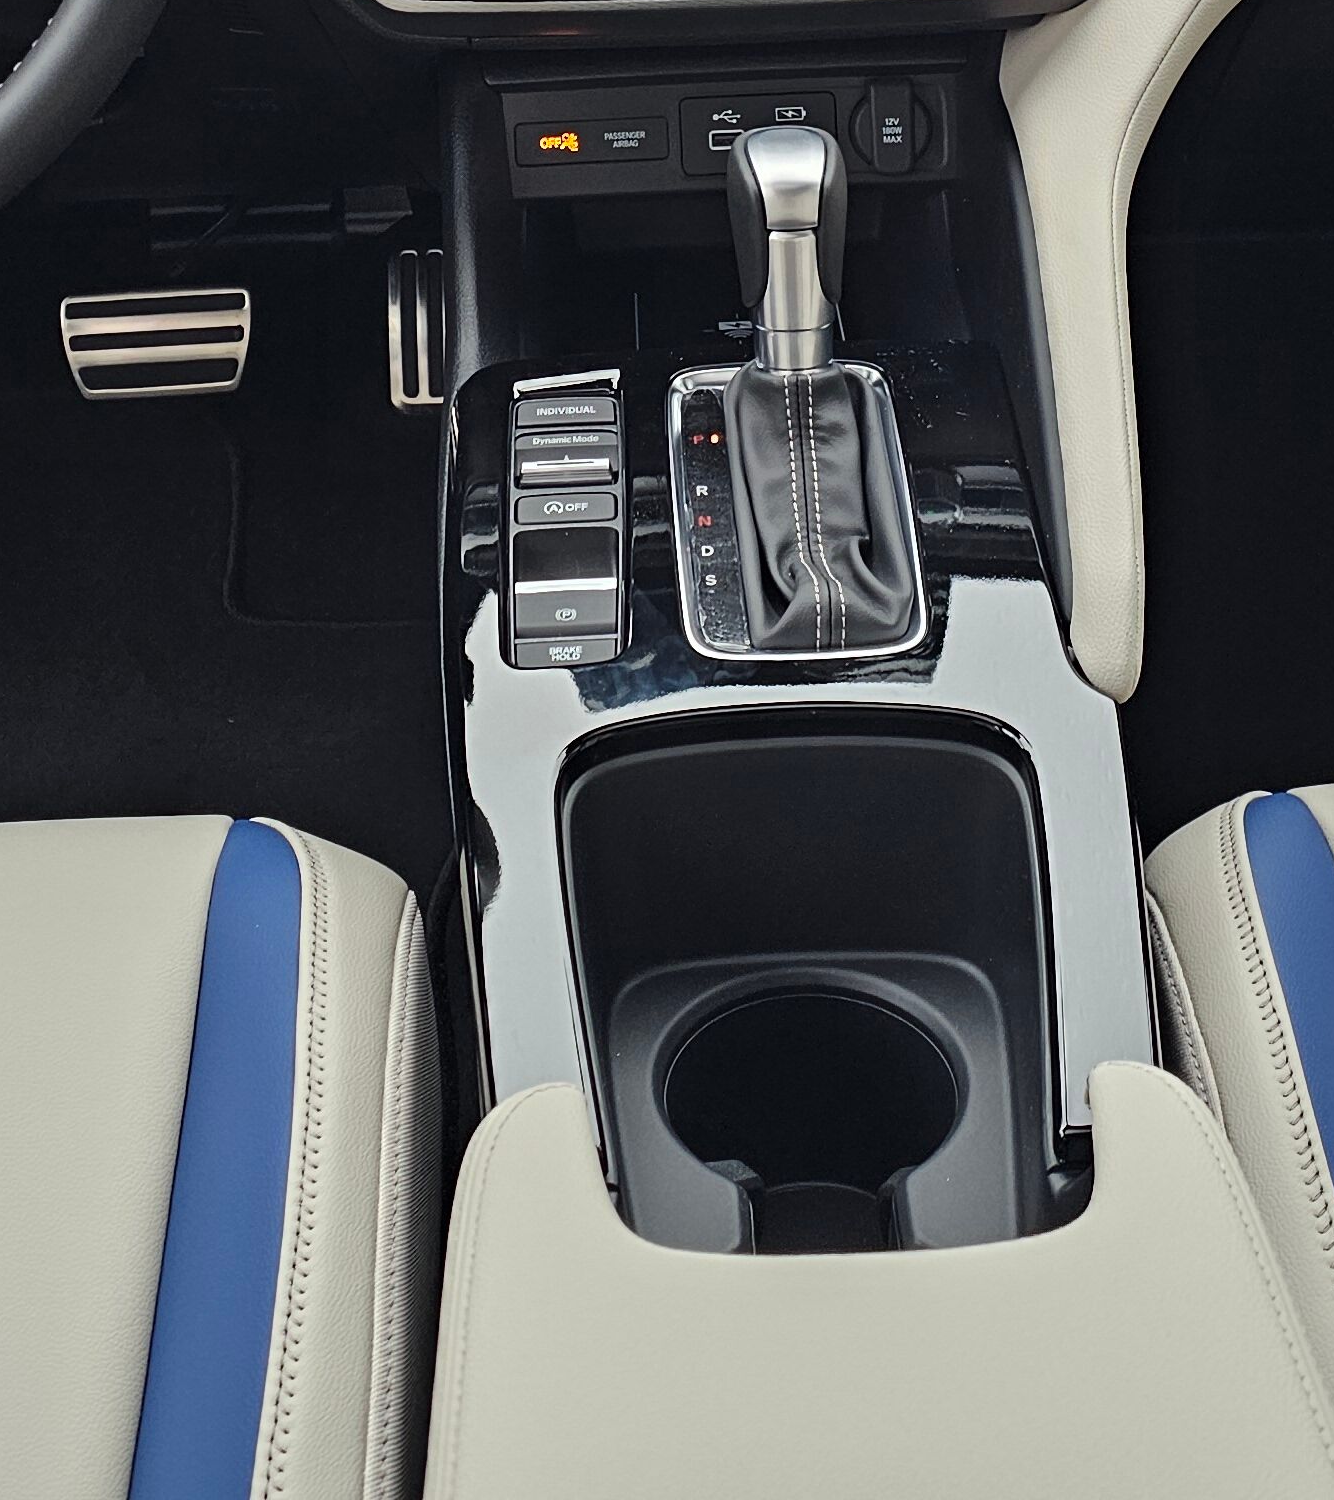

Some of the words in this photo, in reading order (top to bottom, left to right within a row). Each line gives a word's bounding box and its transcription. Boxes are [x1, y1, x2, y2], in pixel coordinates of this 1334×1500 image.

[885, 117, 900, 126] 12V
[604, 130, 646, 141] PASSENGER
[882, 126, 903, 135] 180W
[539, 136, 562, 151] OFF
[612, 139, 639, 149] AIRBAG
[883, 135, 902, 143] MAX
[536, 406, 596, 416] INDIVIDUAL
[532, 435, 571, 446] Dynamic
[572, 434, 599, 443] Mode
[692, 435, 704, 444] P
[696, 486, 708, 496] R
[566, 502, 589, 512] OFF
[698, 515, 712, 526] N
[701, 546, 714, 556] D
[705, 575, 717, 586] S
[549, 646, 582, 655] BRAKE
[551, 653, 580, 662] HOLD
